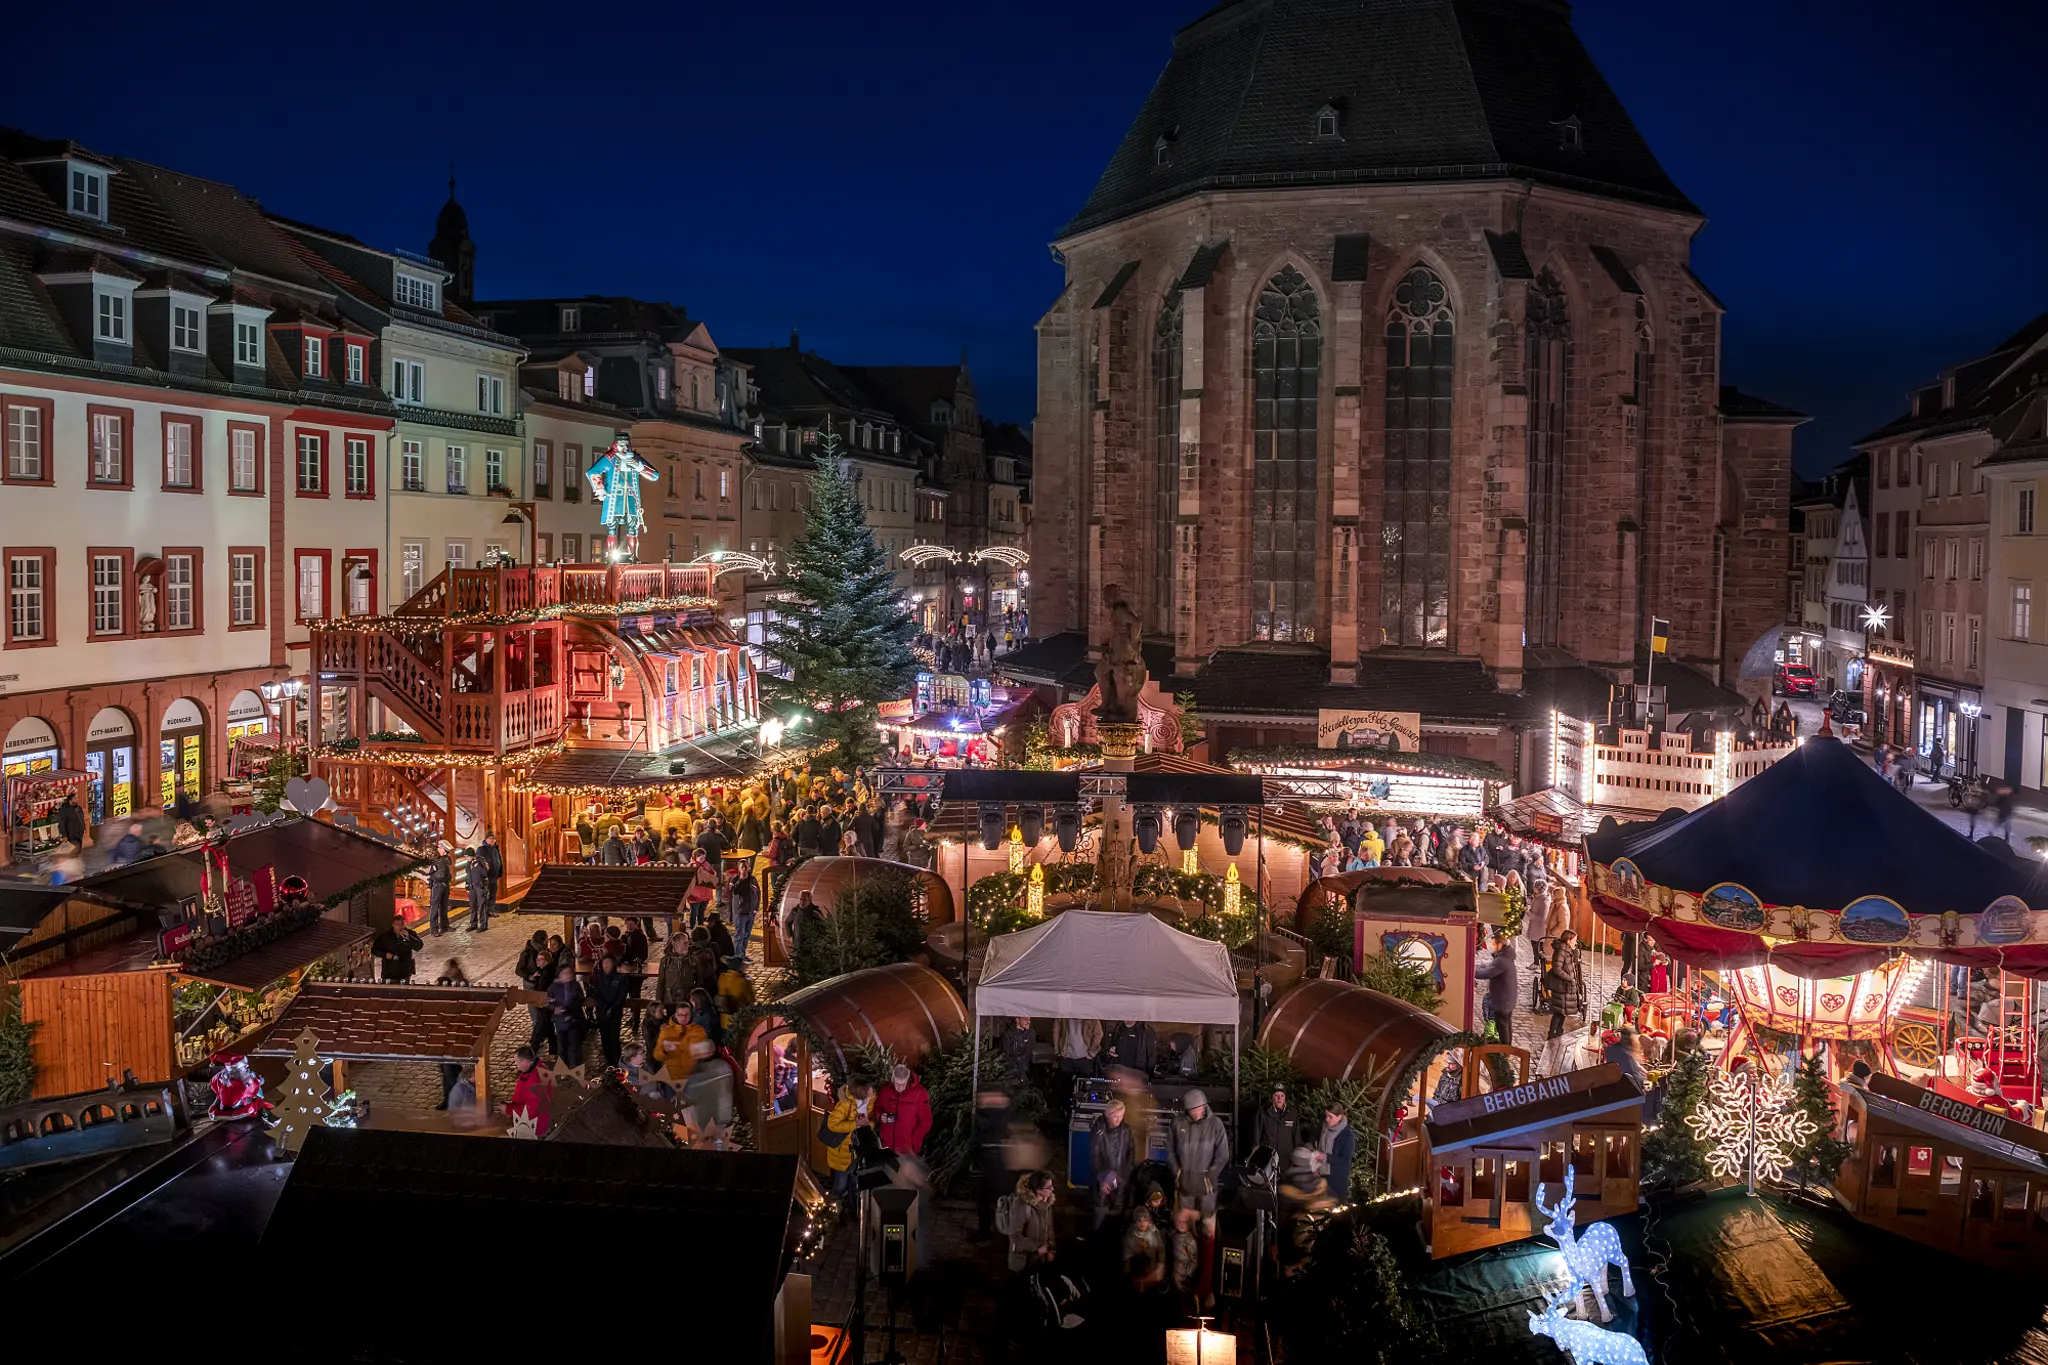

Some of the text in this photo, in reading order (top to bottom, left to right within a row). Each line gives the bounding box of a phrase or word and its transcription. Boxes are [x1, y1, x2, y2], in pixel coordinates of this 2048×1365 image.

[91, 725, 124, 736] CITY-MARKT
[1319, 715, 1368, 738] Heidelberger
[5, 735, 50, 748] LEBENSMITTEL
[1483, 1076, 1571, 1113] BERGBAHN
[1918, 1091, 2006, 1137] BERGBAHN
